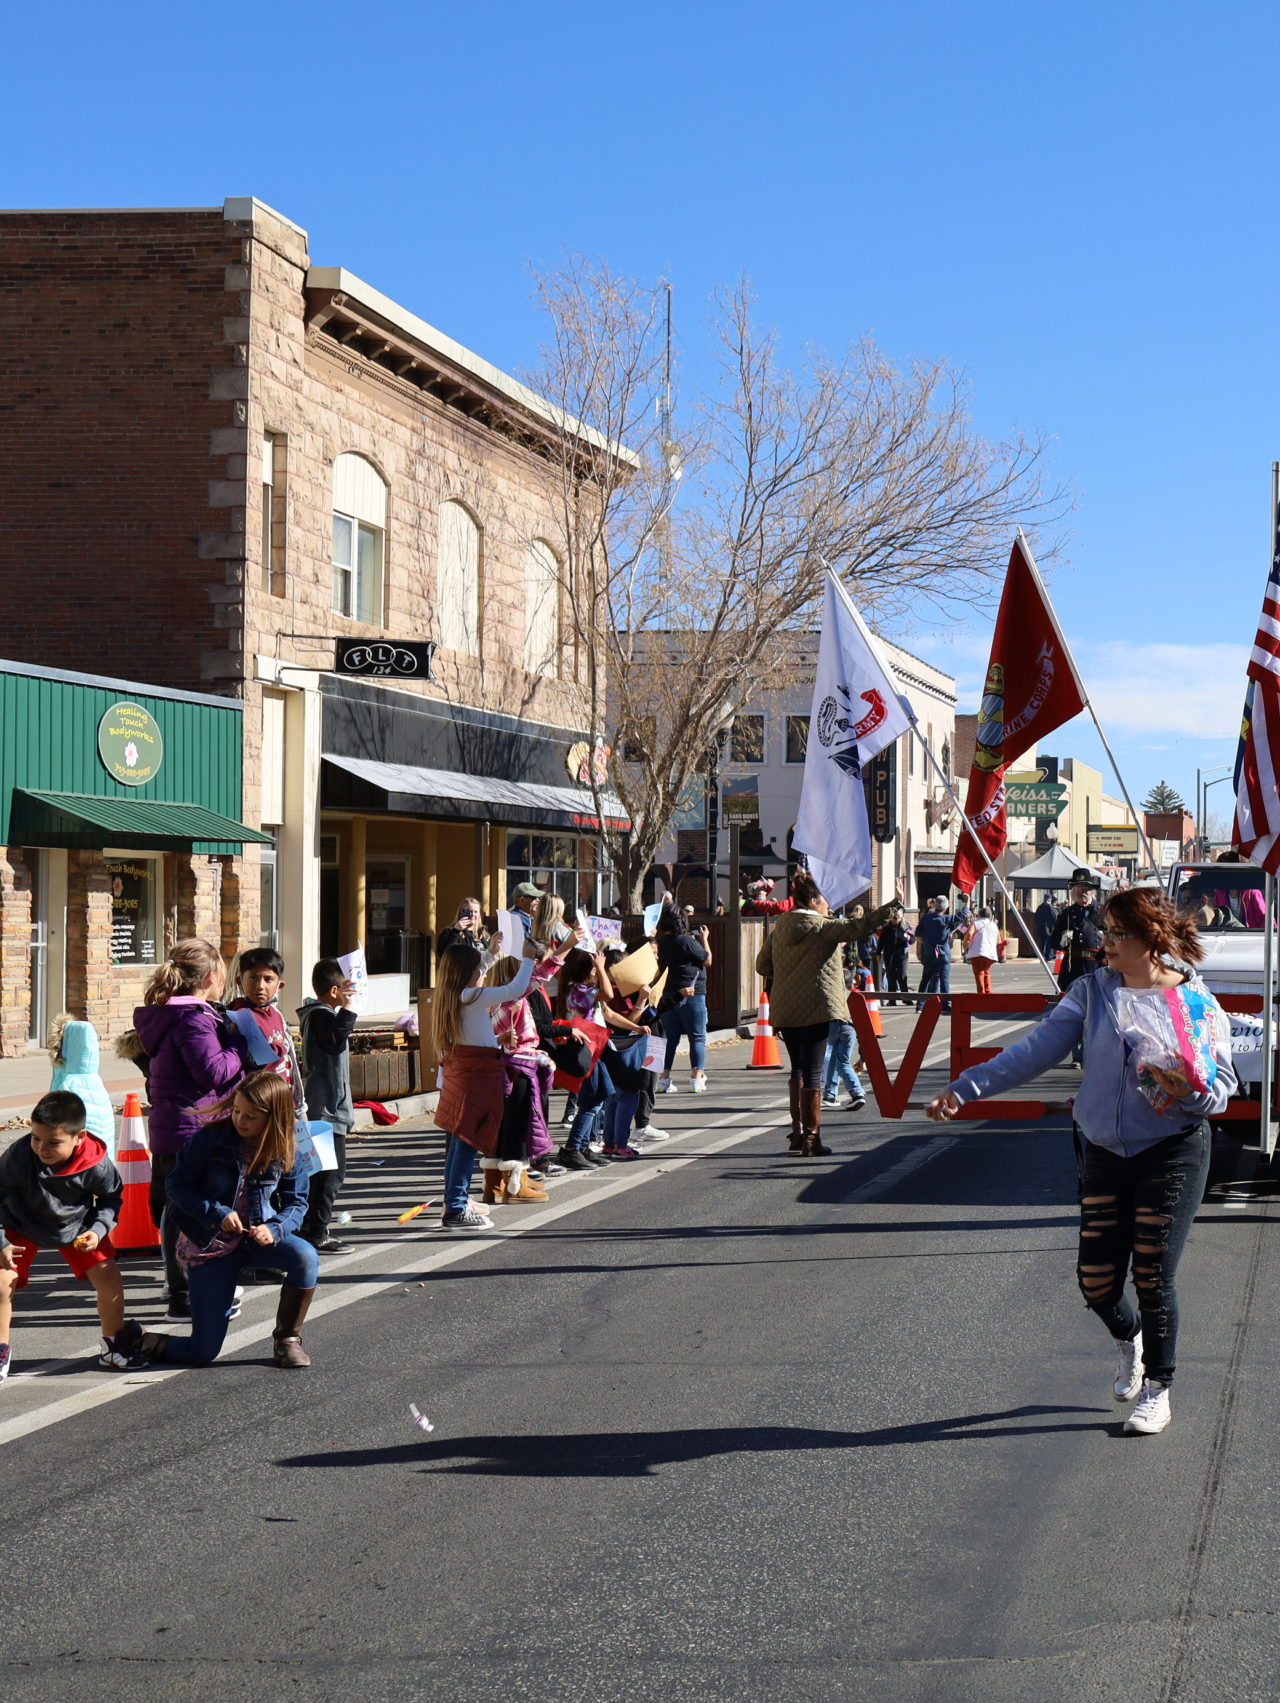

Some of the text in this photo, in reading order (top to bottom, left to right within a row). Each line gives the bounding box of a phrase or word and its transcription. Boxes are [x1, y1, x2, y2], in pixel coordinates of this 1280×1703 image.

[373, 666, 391, 674] 134
[1029, 670, 1052, 710] CORPS
[116, 706, 149, 724] Healing
[120, 717, 144, 730] Touch
[854, 711, 880, 733] RMY
[1002, 713, 1029, 738] RINE
[109, 726, 154, 744] Bodyworks
[876, 770, 887, 824] PUB
[1007, 803, 1057, 815] ANERS
[1238, 1043, 1250, 1052] to
